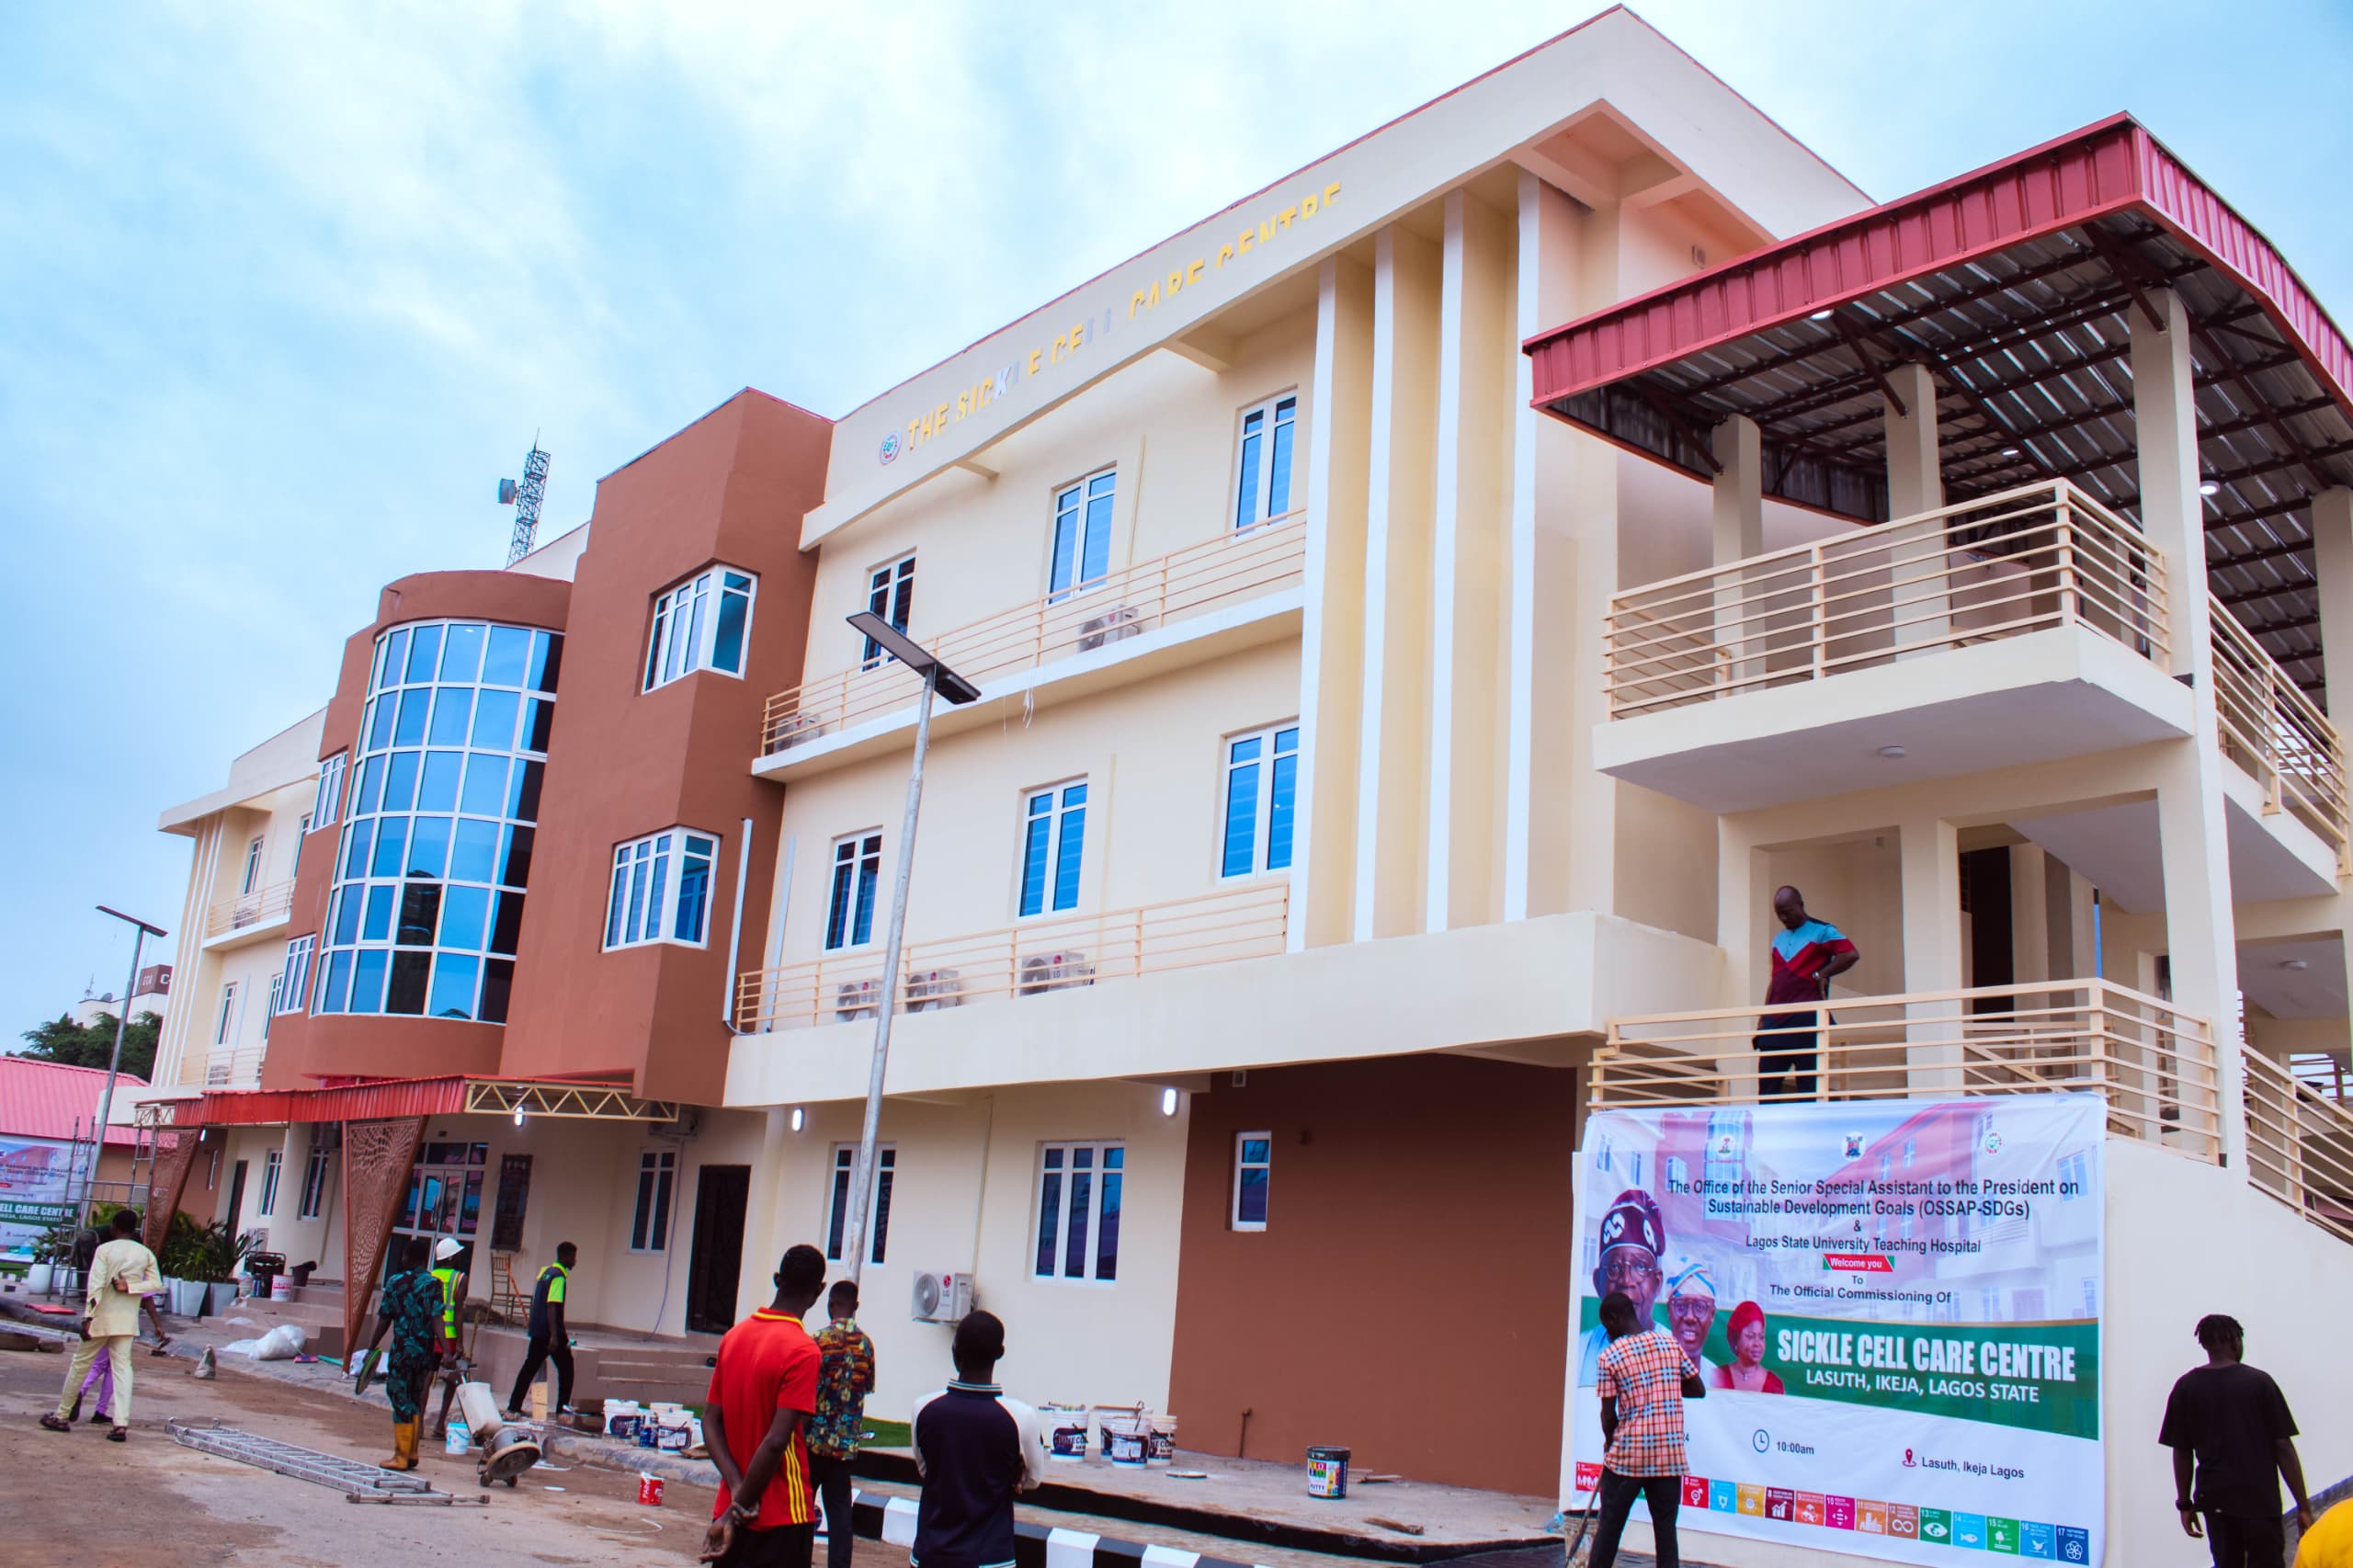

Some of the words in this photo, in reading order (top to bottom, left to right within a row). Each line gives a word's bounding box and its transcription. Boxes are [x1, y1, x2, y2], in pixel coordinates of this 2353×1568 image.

[1668, 1179, 1690, 1193] The
[1693, 1179, 1728, 1194] Office
[1732, 1179, 1745, 1194] of
[1747, 1179, 1767, 1194] the
[1770, 1179, 1813, 1195] Senior
[1815, 1179, 1864, 1199] Special
[1868, 1179, 1934, 1195] Assistant
[1937, 1180, 1951, 1195] to
[1955, 1179, 1978, 1195] the
[1983, 1179, 2055, 1195] President
[2059, 1182, 2079, 1195] on
[15, 1204, 40, 1215] CARE
[1708, 1199, 1780, 1213] Sustainable
[1784, 1199, 1871, 1218] Development
[1874, 1199, 1915, 1215] Goals
[1918, 1199, 2030, 1221] (OSSAP-SDGs)
[1853, 1220, 1861, 1233] &
[1745, 1234, 1779, 1250] Lagos
[1781, 1235, 1809, 1249] State
[1813, 1235, 1870, 1253] University
[1873, 1237, 1927, 1254] Teaching
[1929, 1239, 1981, 1256] Hospital
[1829, 1256, 1866, 1268] Welcome
[1867, 1260, 1882, 1269] you
[1852, 1275, 1864, 1284] To
[1769, 1285, 1790, 1296] The
[1793, 1285, 1834, 1298] Official
[1837, 1288, 1933, 1305] Commissioning
[1936, 1291, 1951, 1303] Of
[1777, 1329, 1853, 1366] SICKLE
[1857, 1334, 1909, 1369] CELL
[1913, 1337, 1975, 1374] CARE
[1980, 1341, 2076, 1381] CENTRE
[1806, 1369, 1871, 1392] LASUTH,
[1875, 1374, 1925, 1396] IKEJA,
[1928, 1378, 1986, 1398] LAGOS
[1989, 1383, 2040, 1403] STATE
[1776, 1441, 1814, 1455] 10:00am
[1922, 1457, 1961, 1472] Lasuth,
[1963, 1460, 1987, 1476] Ikeja
[1990, 1464, 2025, 1480] Lagos
